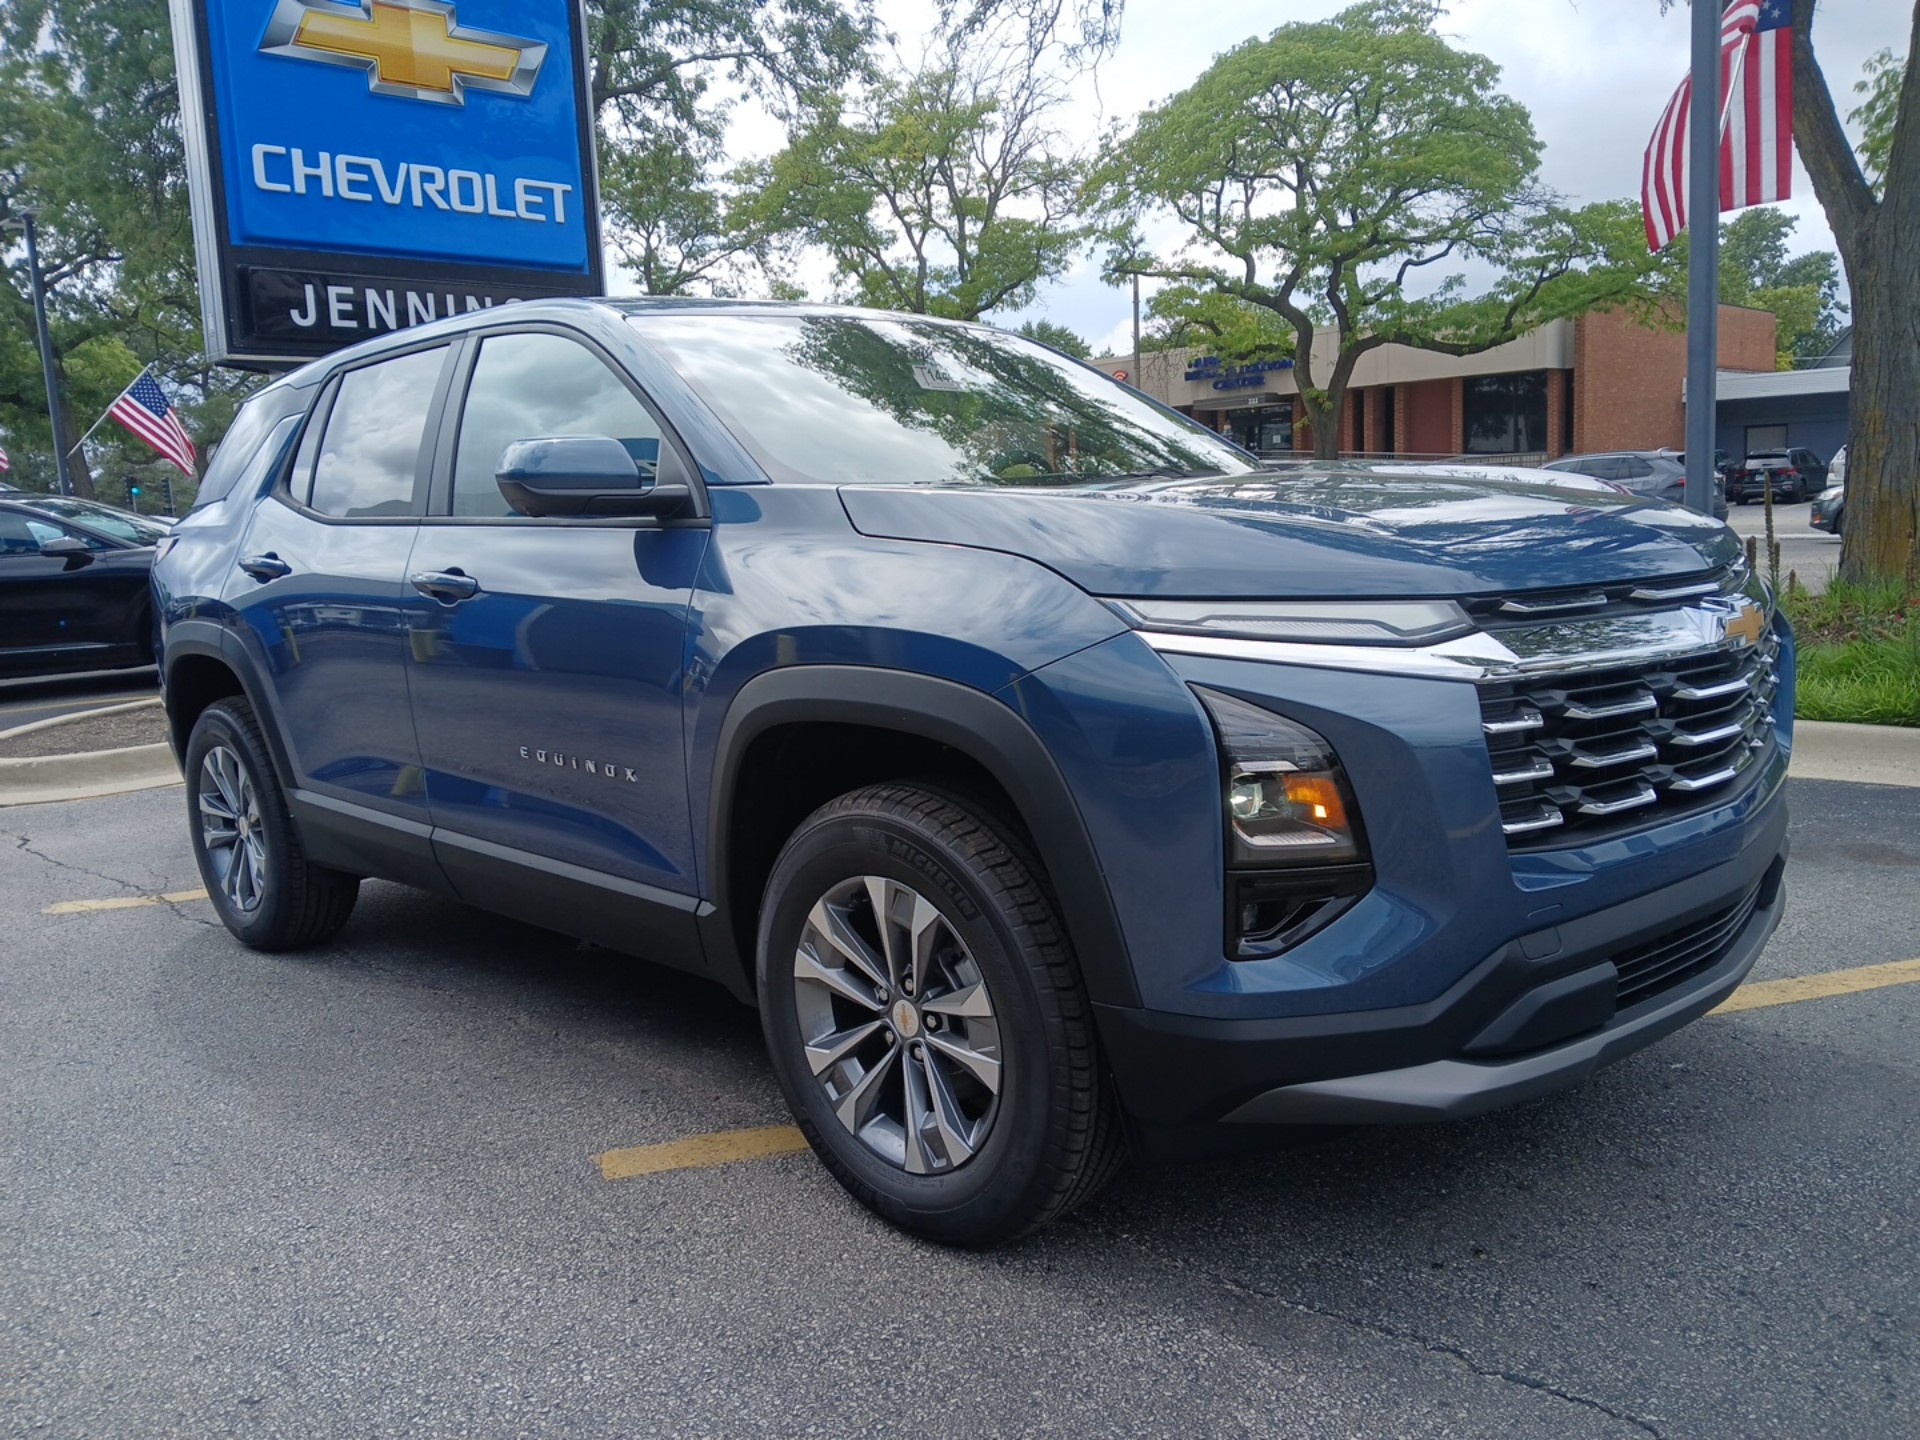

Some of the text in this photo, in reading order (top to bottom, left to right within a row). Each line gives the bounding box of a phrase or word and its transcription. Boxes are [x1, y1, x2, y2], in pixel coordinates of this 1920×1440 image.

[251, 143, 572, 224] CHEVROLET
[289, 283, 524, 330] JENNI
[519, 746, 638, 783] EQUINOX
[890, 839, 977, 920] MICHELIN
